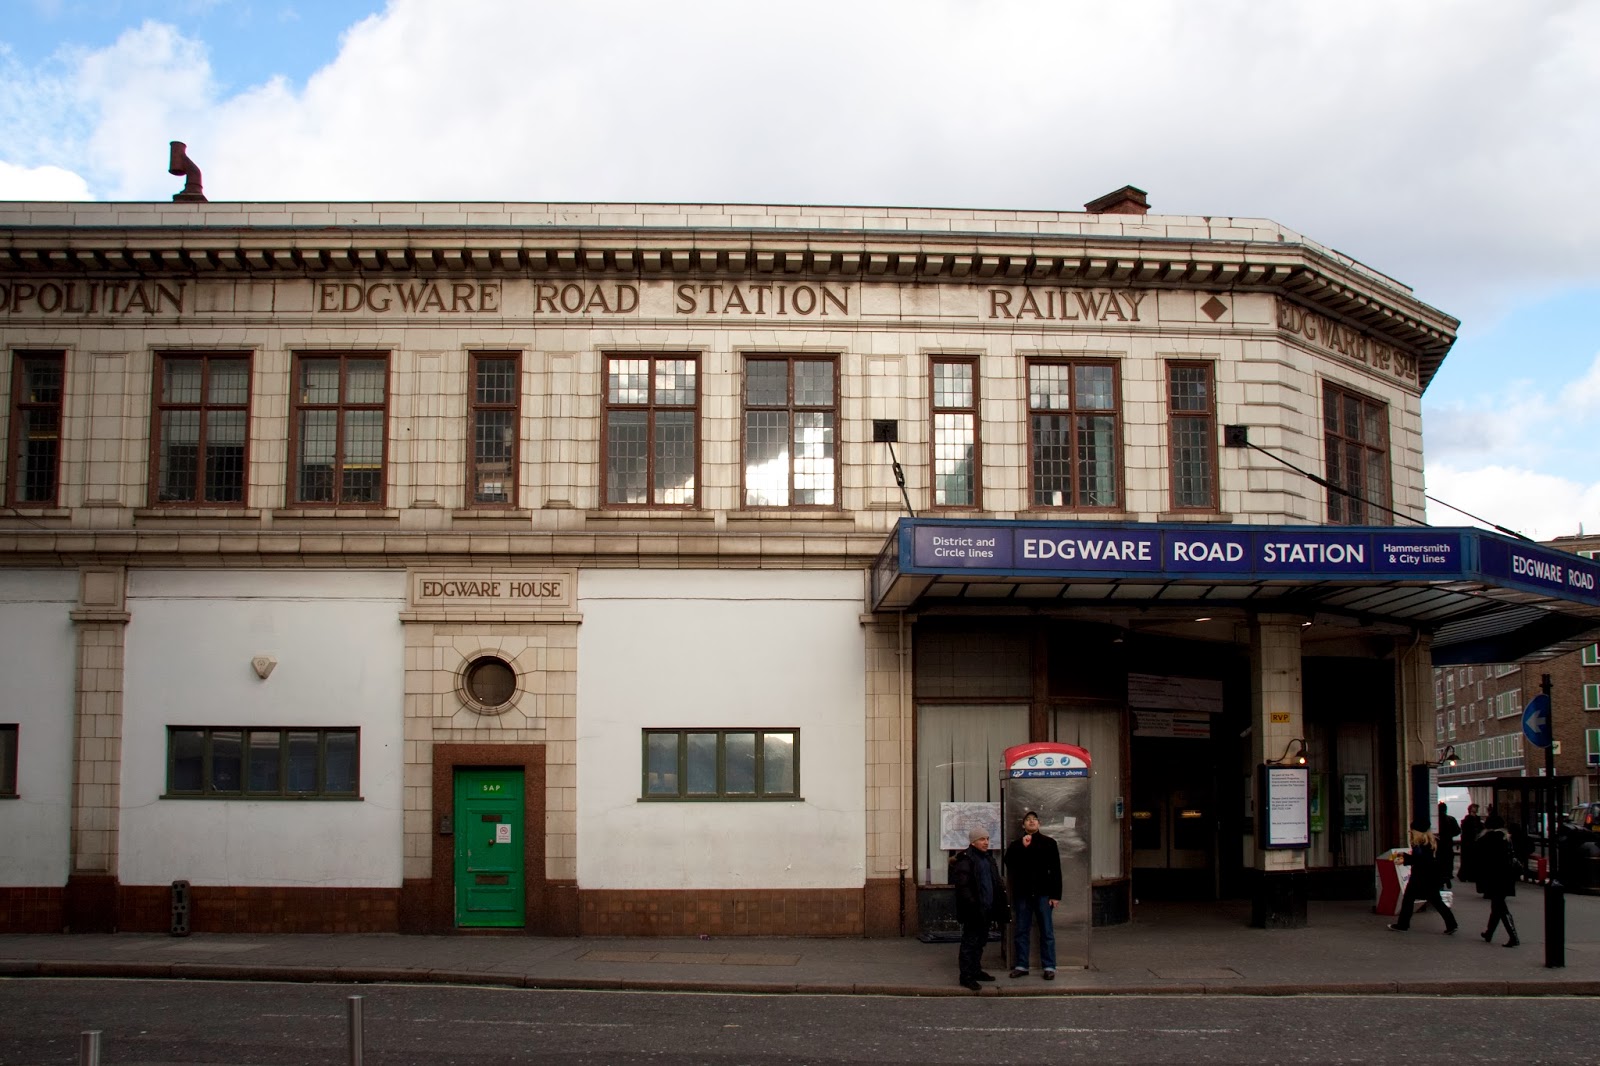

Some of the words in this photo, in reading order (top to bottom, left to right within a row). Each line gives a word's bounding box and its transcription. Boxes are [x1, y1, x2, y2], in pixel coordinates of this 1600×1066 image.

[318, 283, 499, 313] EDGWARE
[534, 283, 640, 314] ROAD
[676, 284, 850, 316] STATION
[987, 289, 1149, 322] RAILWAY
[1278, 300, 1367, 363] EDGWARE
[933, 536, 973, 547] District
[976, 538, 996, 547] and
[1383, 543, 1451, 553] Hammersmith
[934, 547, 966, 558] Circle
[968, 548, 994, 558] lines
[1023, 539, 1152, 560] EDGWARE
[1173, 541, 1244, 563] ROAD
[1263, 542, 1364, 564] STATION
[1388, 554, 1397, 563] &
[1399, 554, 1420, 565] City
[1422, 554, 1446, 563] lines
[1512, 554, 1563, 584] EDGWARE
[1568, 568, 1594, 590] ROAD
[422, 581, 501, 597] EDGWARE
[509, 582, 561, 598] HOUSE
[1272, 713, 1290, 722] RVP
